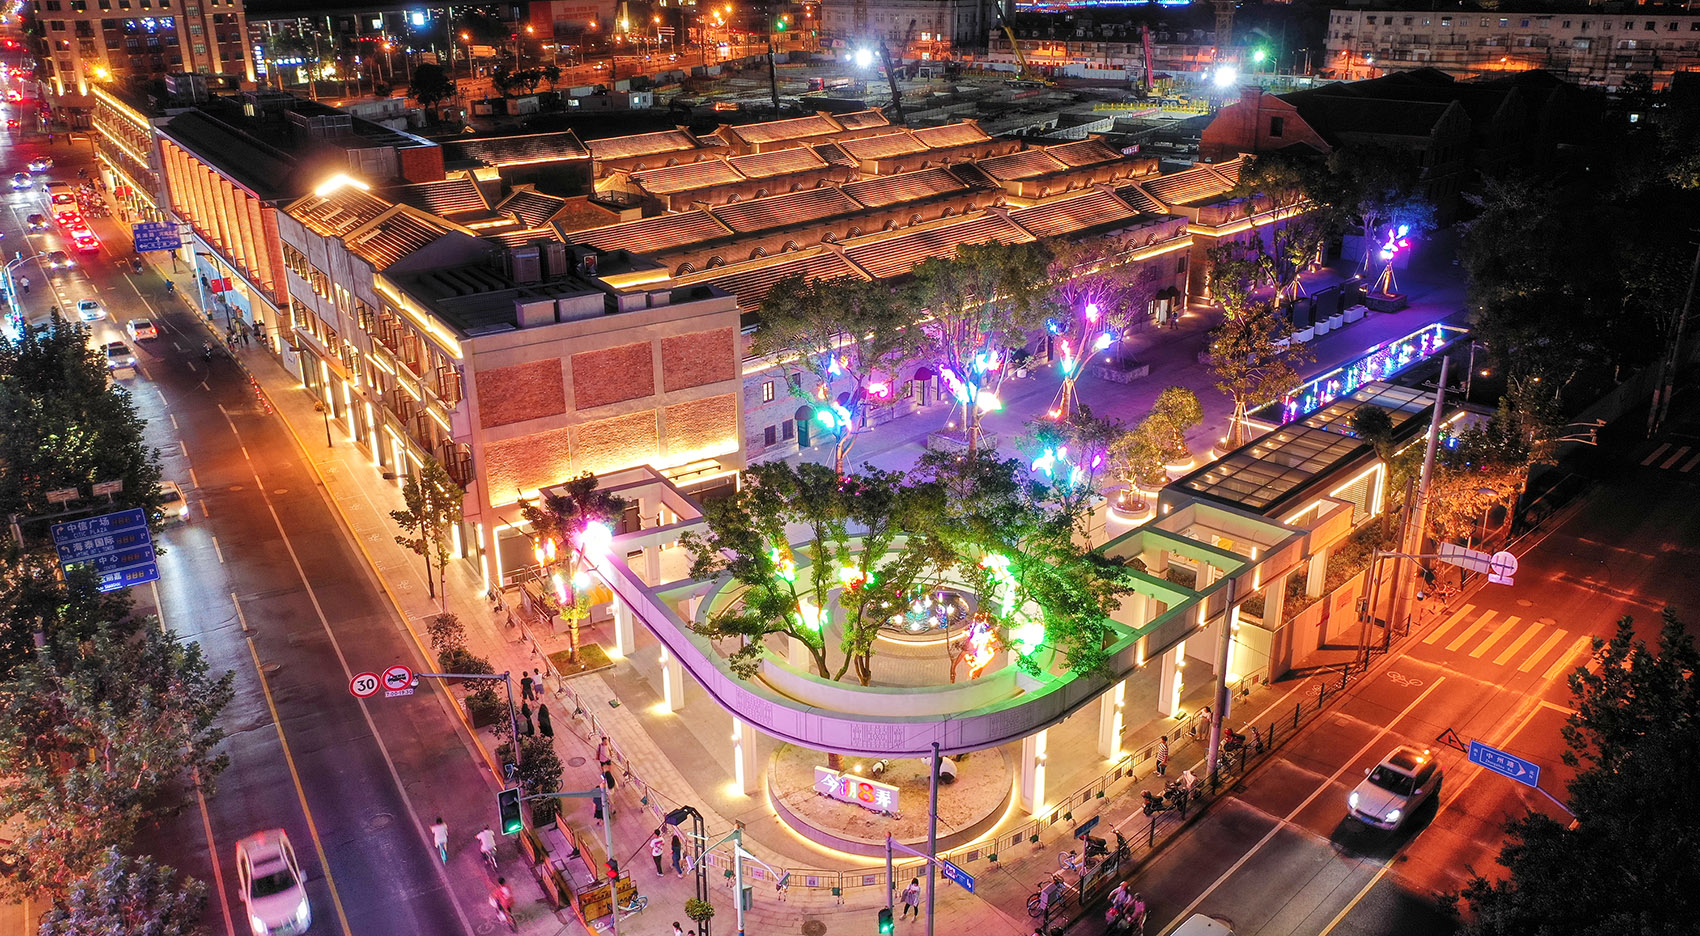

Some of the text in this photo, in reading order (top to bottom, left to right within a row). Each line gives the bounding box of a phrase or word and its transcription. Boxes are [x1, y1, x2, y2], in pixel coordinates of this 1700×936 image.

[67, 517, 110, 532] 中信广场
[73, 536, 115, 551] 海泰国际
[357, 678, 375, 691] 30
[1486, 753, 1514, 768] 中州路
